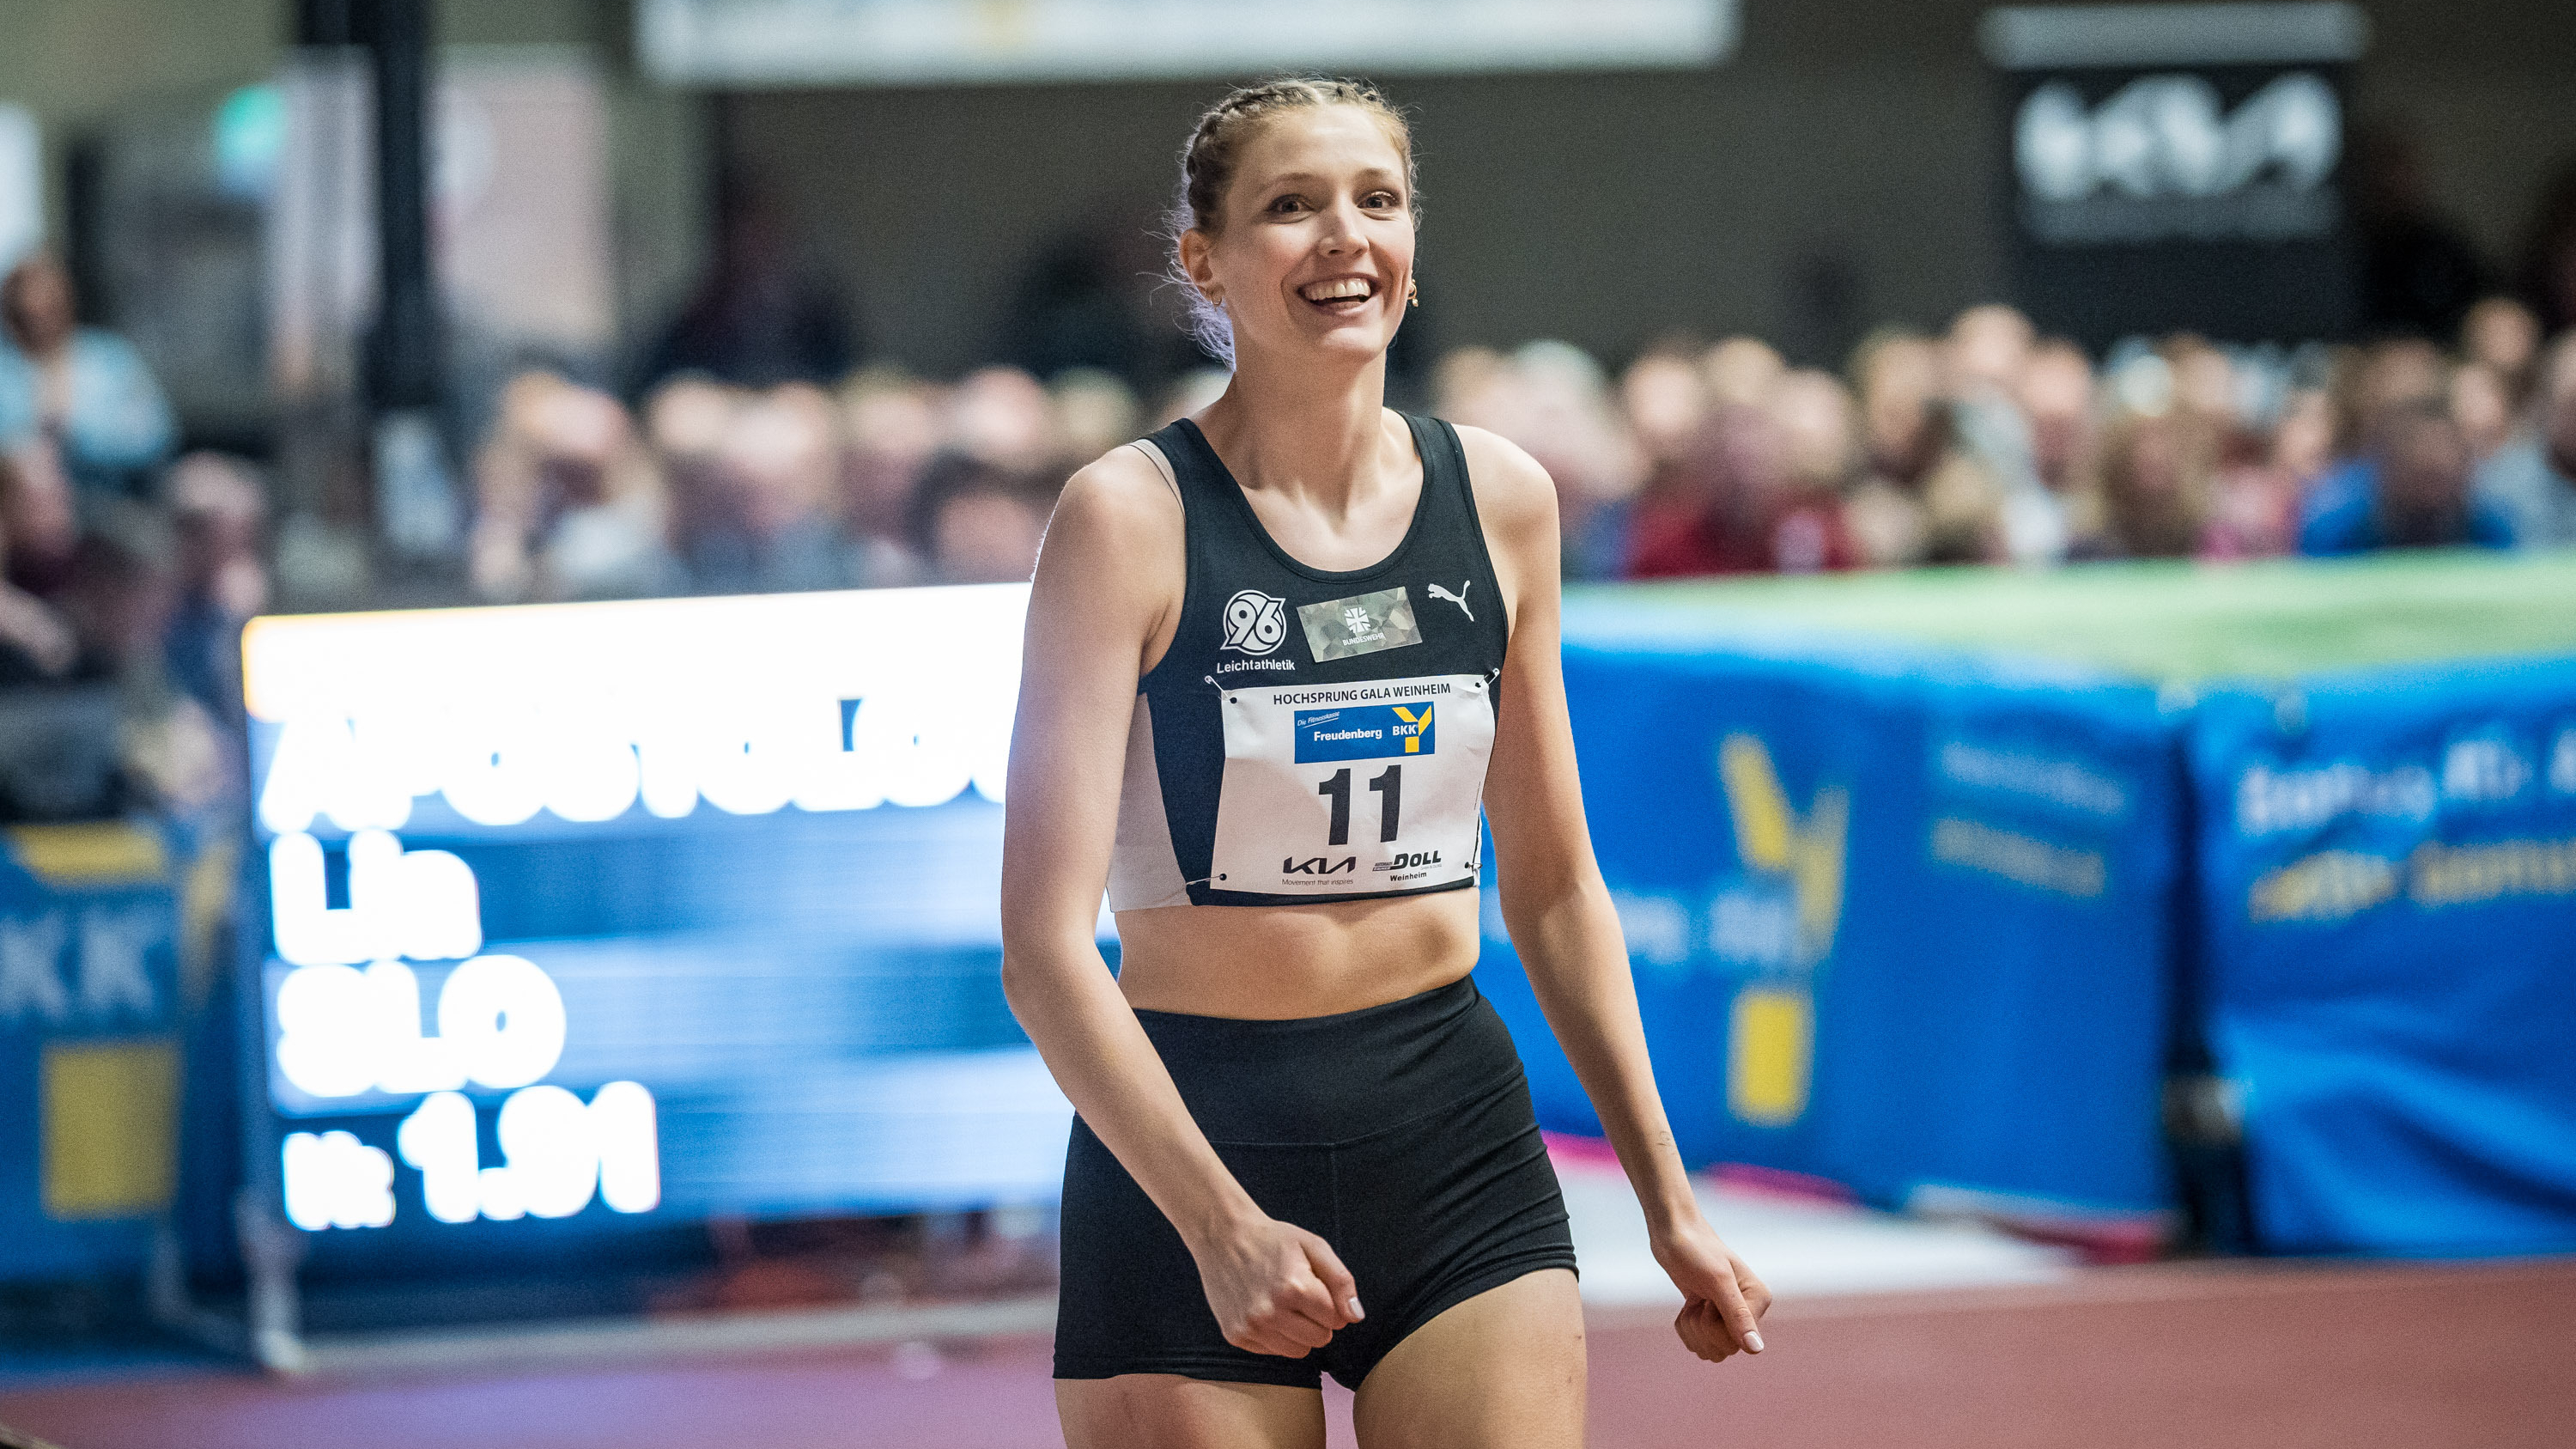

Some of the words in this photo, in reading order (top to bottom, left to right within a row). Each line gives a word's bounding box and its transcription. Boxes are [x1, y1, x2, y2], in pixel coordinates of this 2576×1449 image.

[1229, 600, 1282, 645] 96
[1342, 632, 1386, 646] BUNDESWEHR
[1216, 659, 1296, 673] Leichtathletik
[1273, 690, 1358, 705] HOCHSPRUNG
[1360, 686, 1391, 699] GALA
[1393, 683, 1451, 697] WEINHEIM
[1314, 728, 1382, 741] Freudenberg
[1392, 724, 1417, 736] BKK
[1318, 764, 1402, 846] 11
[1283, 856, 1357, 874] KIA
[1392, 850, 1442, 870] DOLL
[1390, 871, 1427, 881] Weinheim
